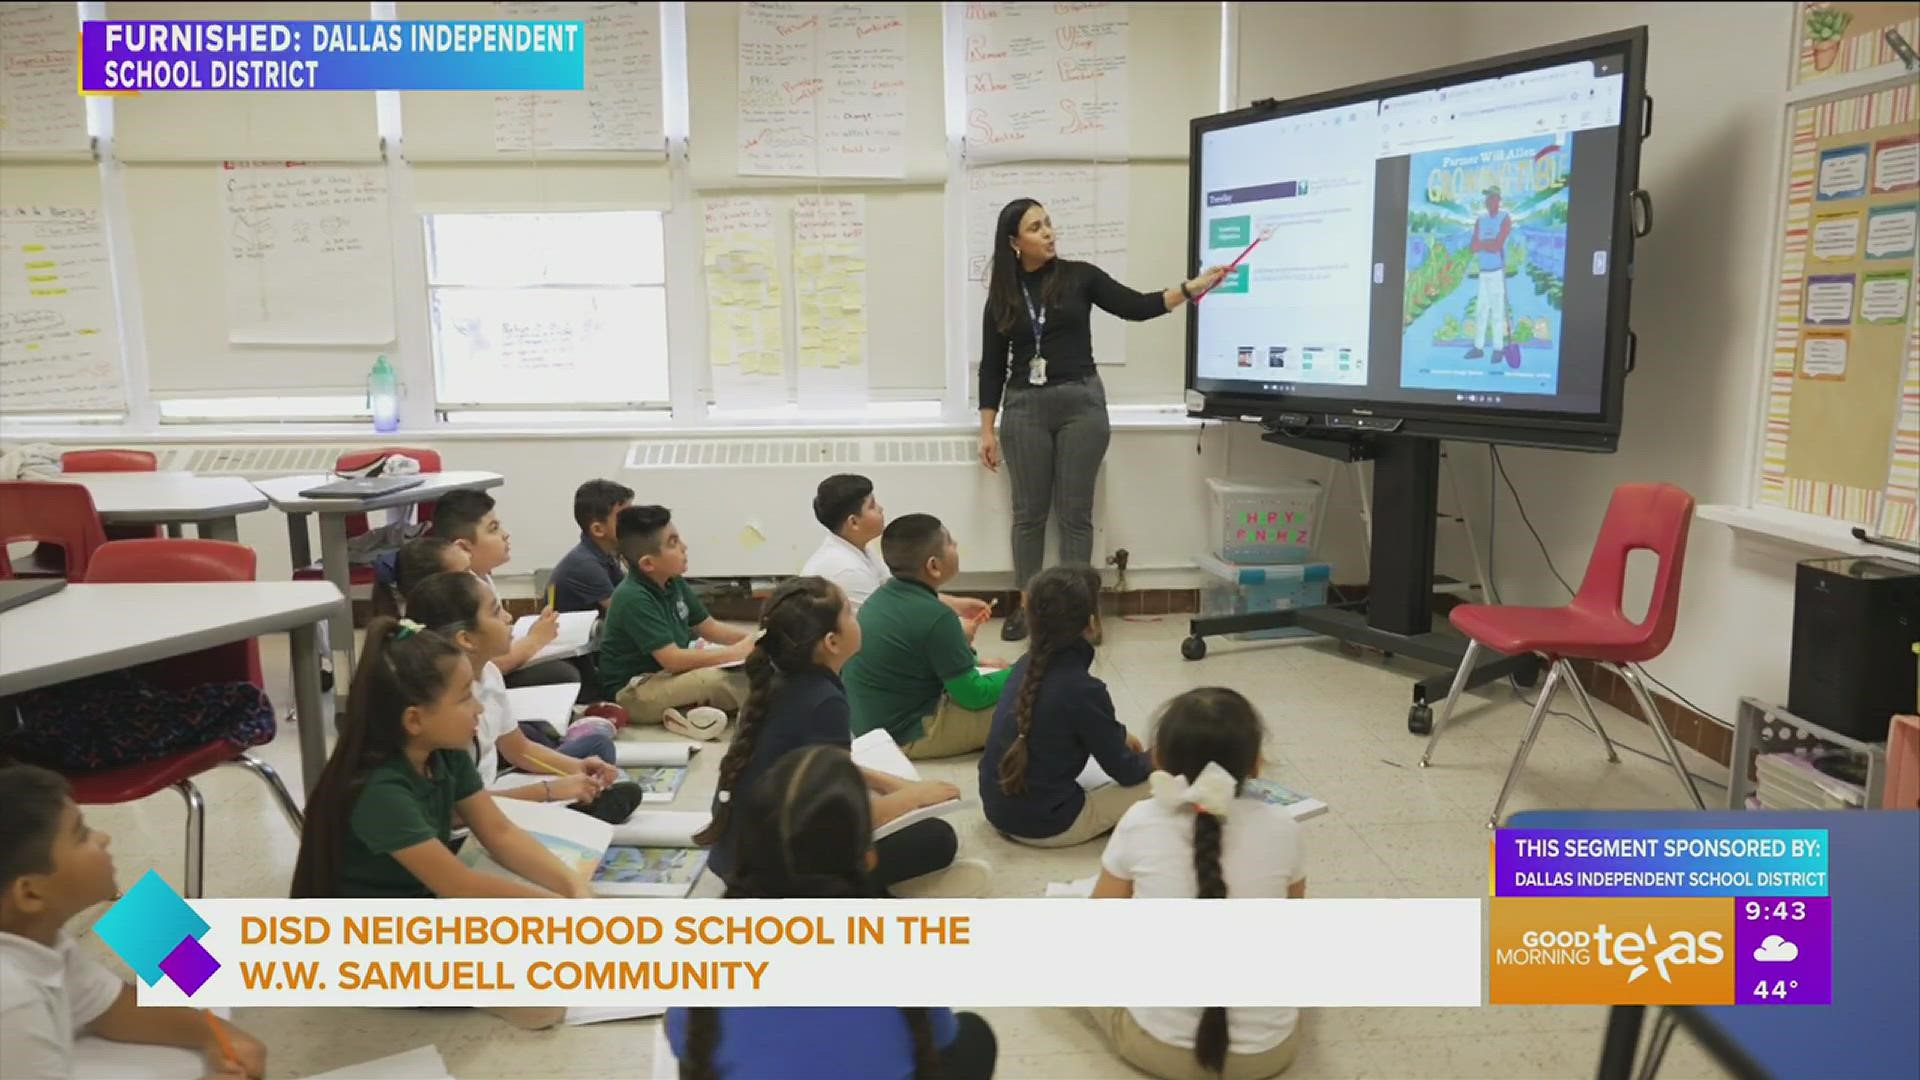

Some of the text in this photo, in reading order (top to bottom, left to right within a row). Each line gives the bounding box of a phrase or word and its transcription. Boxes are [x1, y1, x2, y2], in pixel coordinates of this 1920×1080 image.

[1442, 147, 1537, 168] Farmer Will Allen
